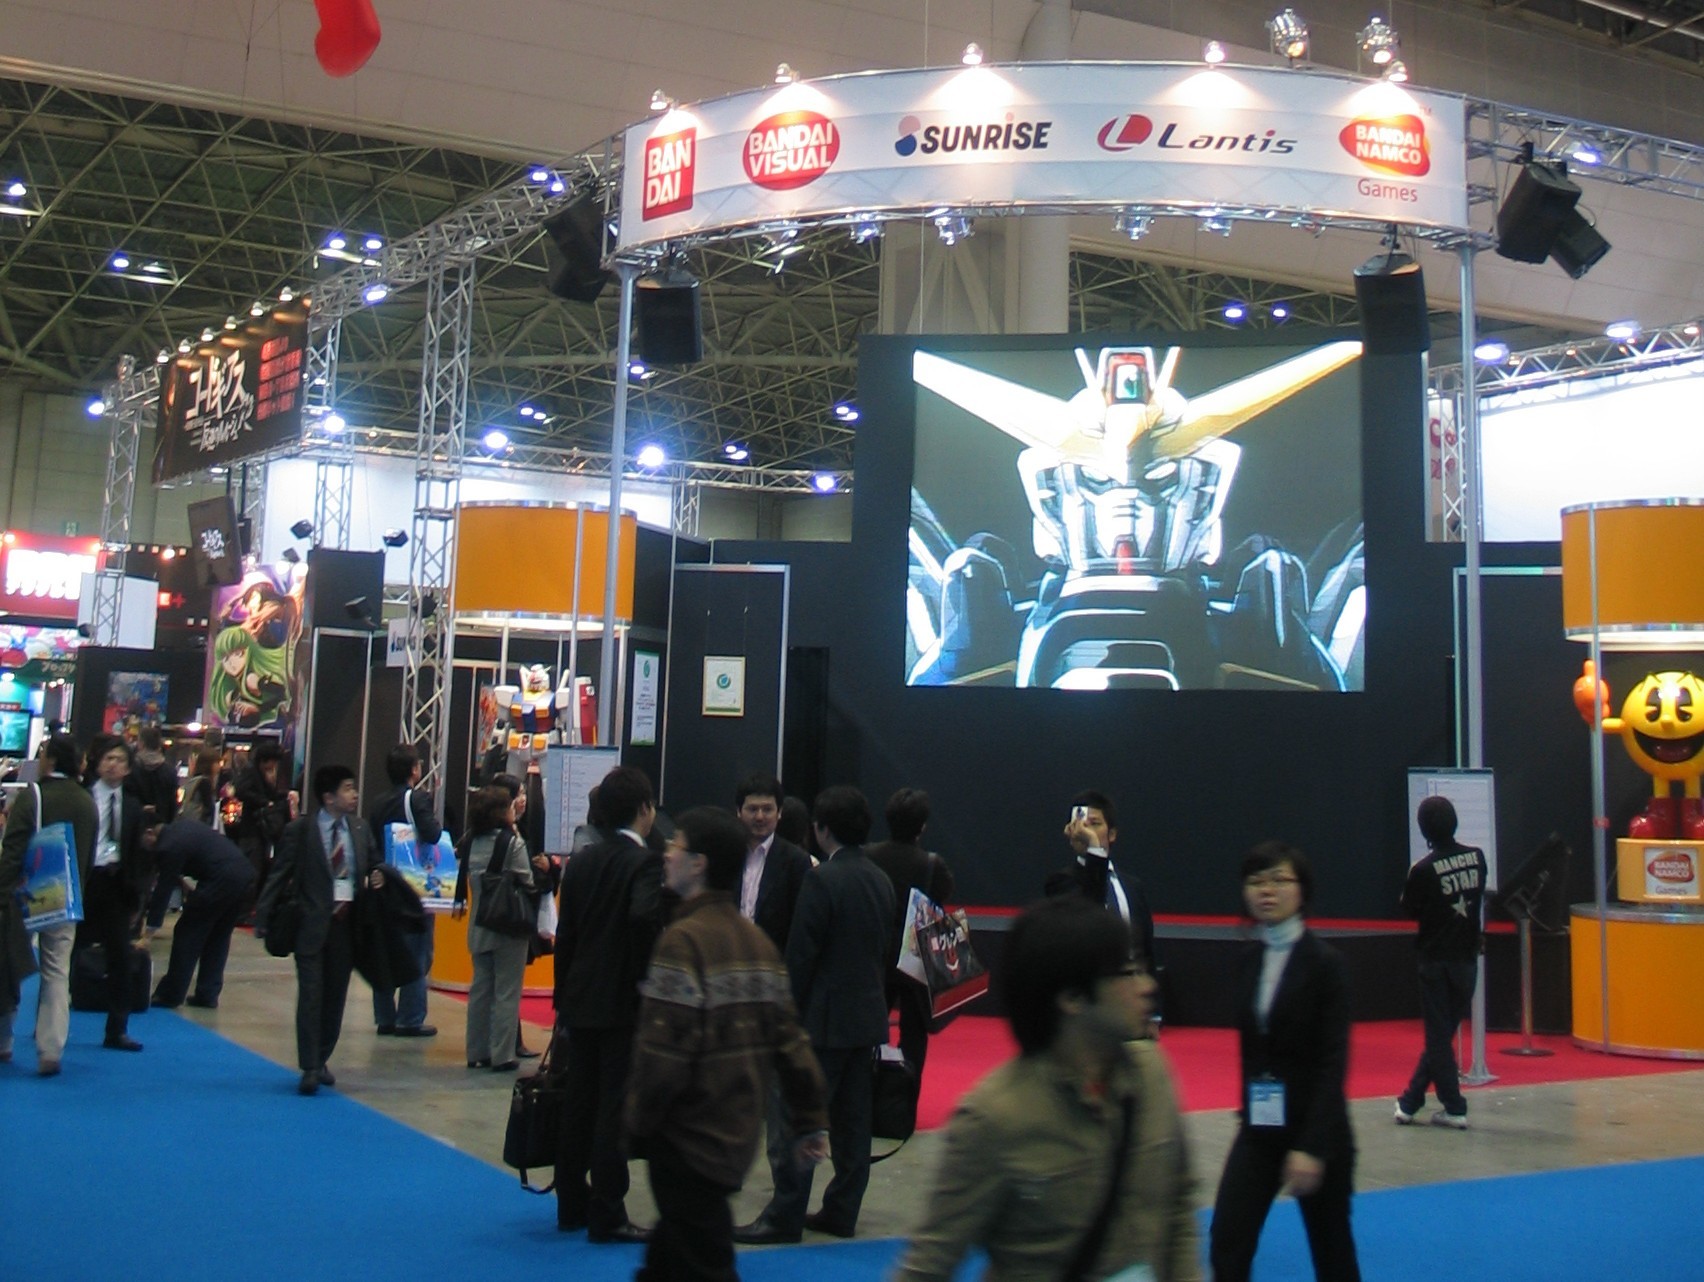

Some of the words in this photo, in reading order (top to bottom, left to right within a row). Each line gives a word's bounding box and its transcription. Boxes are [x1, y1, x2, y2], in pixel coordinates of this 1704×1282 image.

[749, 122, 833, 154] BANDAI
[921, 112, 1053, 153] SUNRISE
[1157, 123, 1298, 154] Lantis
[1355, 124, 1420, 148] BANDAI
[648, 139, 692, 177] BAN
[750, 146, 832, 177] VISUAL
[1356, 142, 1421, 165] NAMCO
[646, 170, 682, 208] DAI
[1357, 178, 1418, 202] Games
[1440, 869, 1479, 896] STAR
